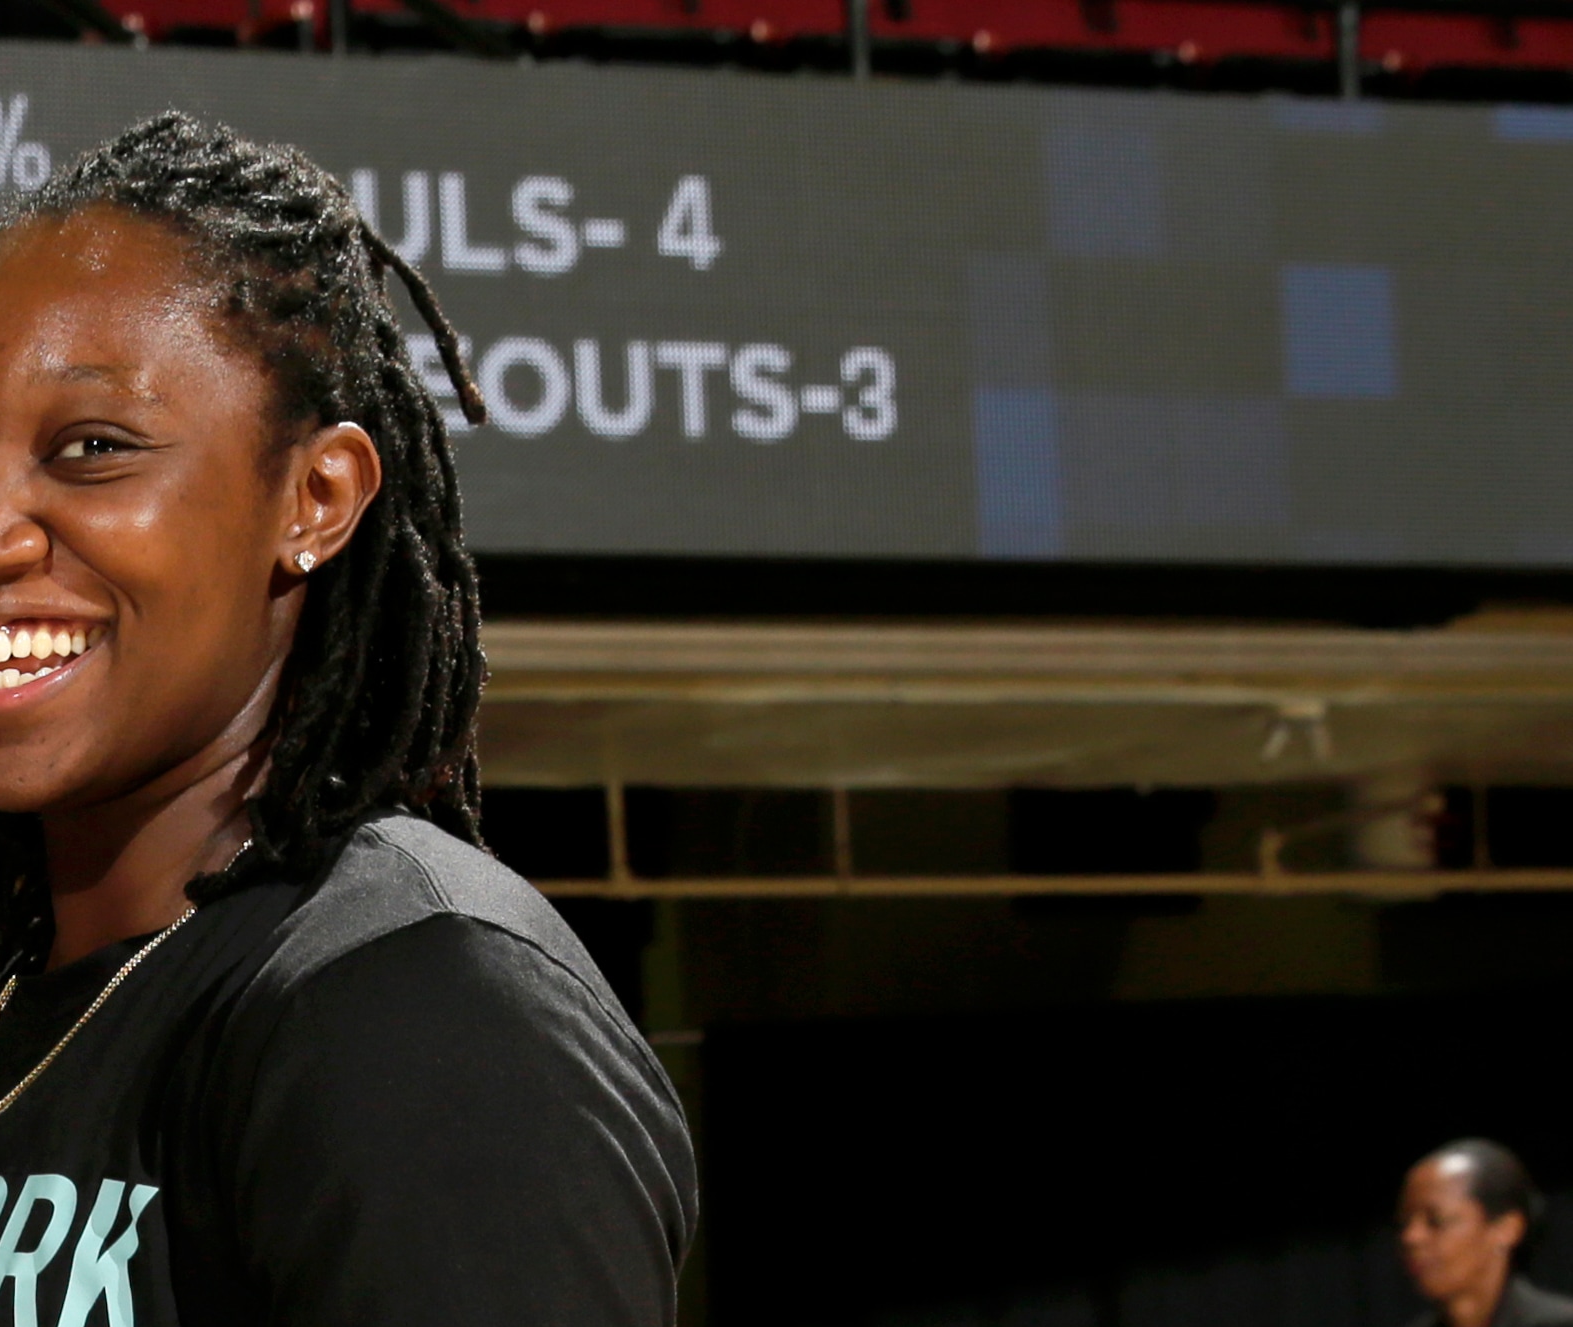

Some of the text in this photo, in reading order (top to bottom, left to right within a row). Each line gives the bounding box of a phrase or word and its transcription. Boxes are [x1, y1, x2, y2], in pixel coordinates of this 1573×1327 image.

[353, 168, 724, 274] ULS- 4
[405, 332, 898, 442] EOUTS-3
